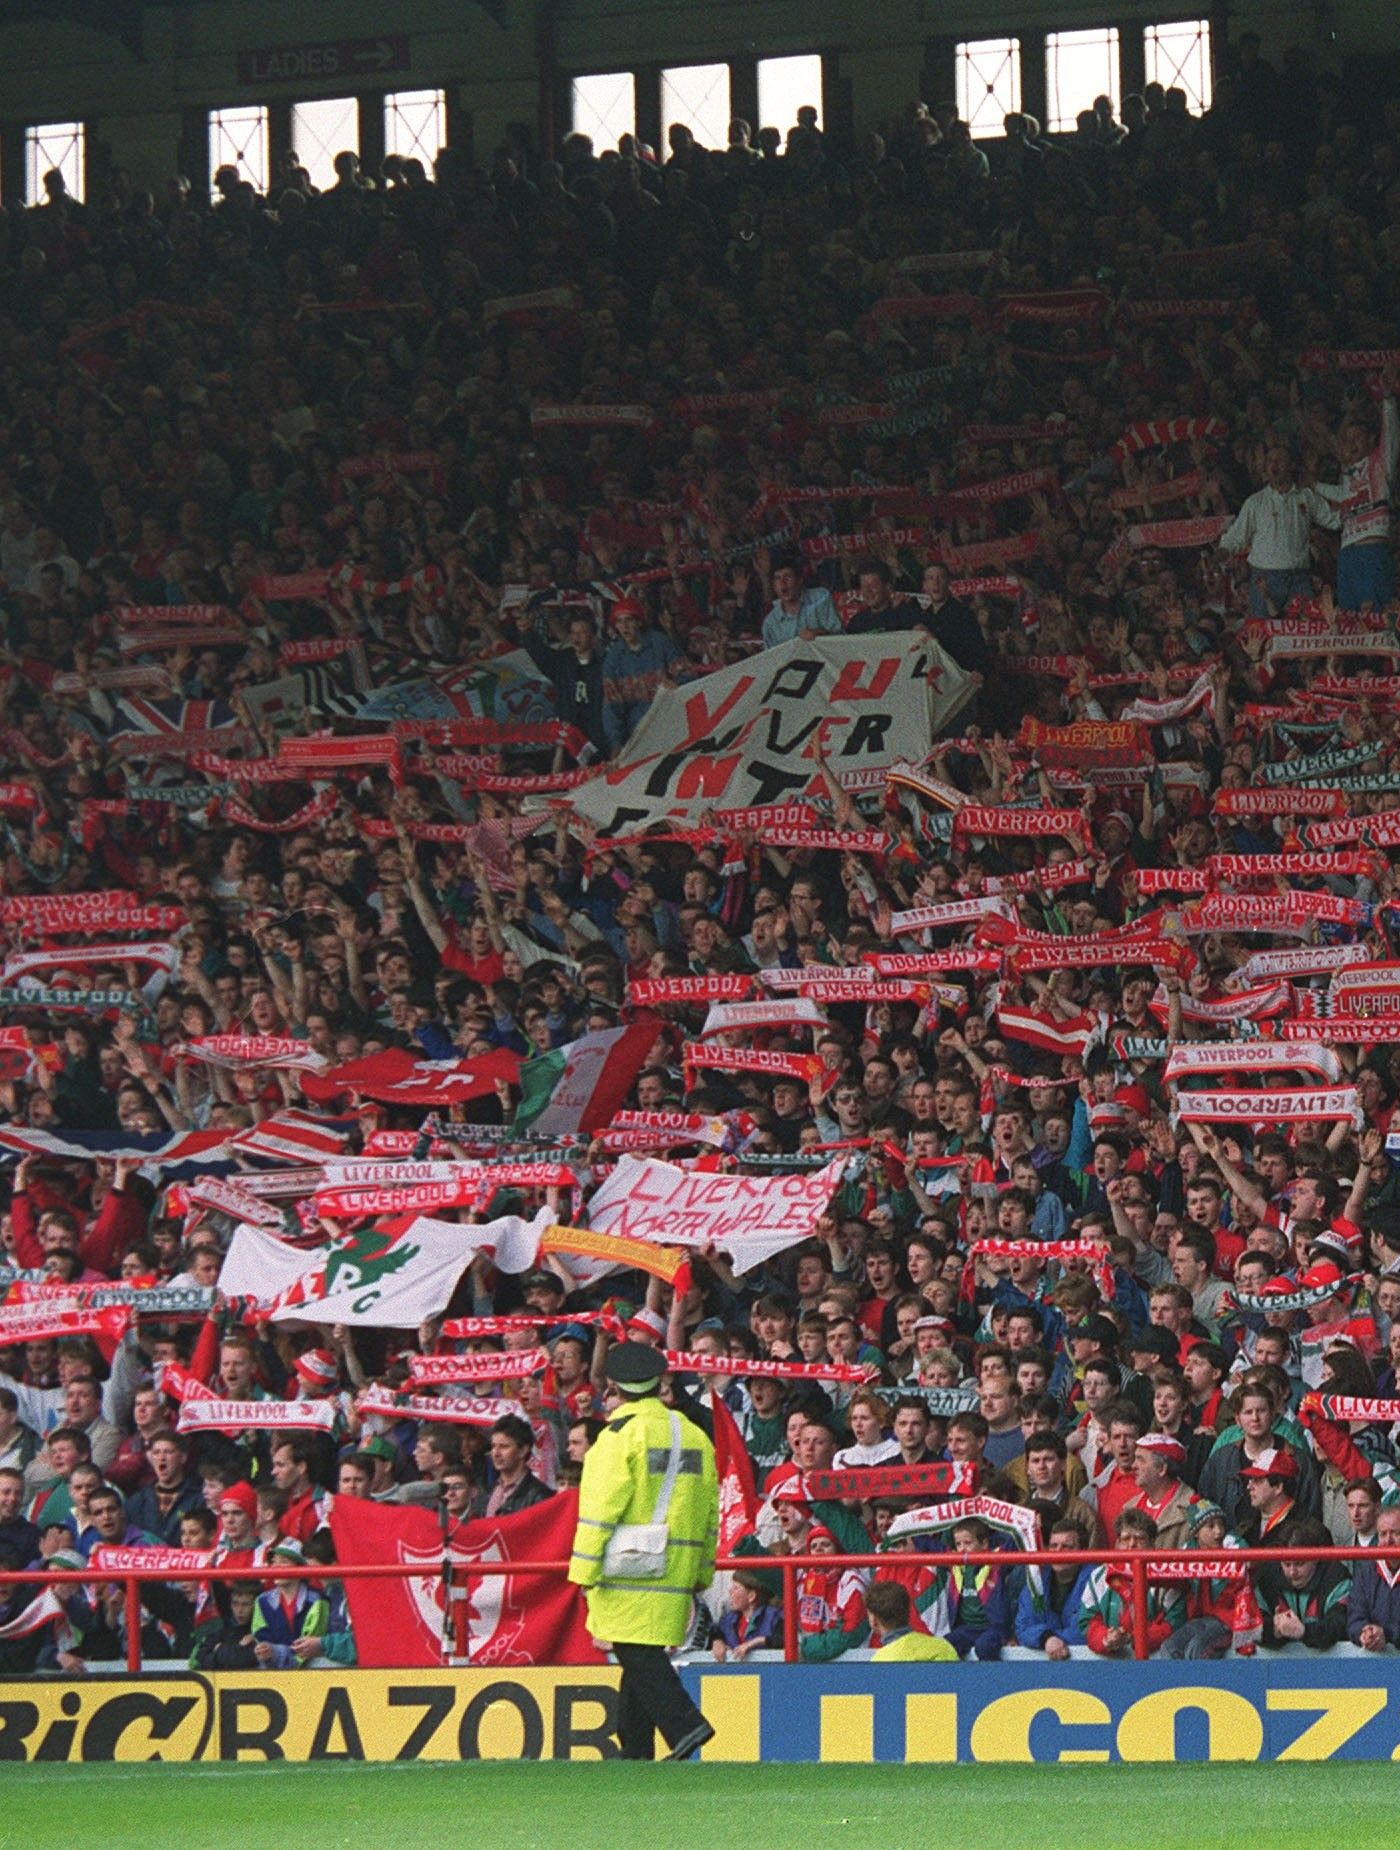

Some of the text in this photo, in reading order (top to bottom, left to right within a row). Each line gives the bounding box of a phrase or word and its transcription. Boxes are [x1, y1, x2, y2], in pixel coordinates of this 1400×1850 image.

[252, 47, 338, 79] LADIES
[1271, 620, 1329, 635] LIVERP
[1293, 636, 1363, 648] LIVERPOOL
[1046, 723, 1135, 746] LIVERPOOL
[1267, 743, 1382, 780] LIVERPOOL
[843, 771, 887, 786] LIVER
[1234, 791, 1331, 811] LIVERPOOL
[962, 810, 1081, 831] LIVERPOOL
[1215, 853, 1348, 868] LIVERPOOL
[1138, 869, 1205, 891] LIVER
[47, 909, 156, 926] LIVERPOOL
[903, 902, 980, 920] LIVERPOOL
[887, 953, 975, 968] LIVERPOOL
[1030, 946, 1151, 963] LIVERPOOL
[780, 970, 843, 982] LIVERPOOL
[635, 976, 741, 997] LIVERPOOL
[814, 983, 907, 996] LIVERPOOL
[205, 1035, 311, 1056] LIVERPOOL
[691, 1046, 791, 1069] LIVERPOOL
[1199, 1048, 1271, 1062] LIVERPOOL
[1210, 1096, 1327, 1116] LIVERPOOL
[344, 1163, 435, 1180] LIVERPOOL
[345, 1191, 453, 1209] LIVERPOOL
[96, 1290, 211, 1307] LIVERPOOL
[213, 1403, 286, 1417] LIVERPOOL
[938, 1499, 1014, 1524] LIVERPOOL
[102, 1552, 206, 1569] LIVERPOOL
